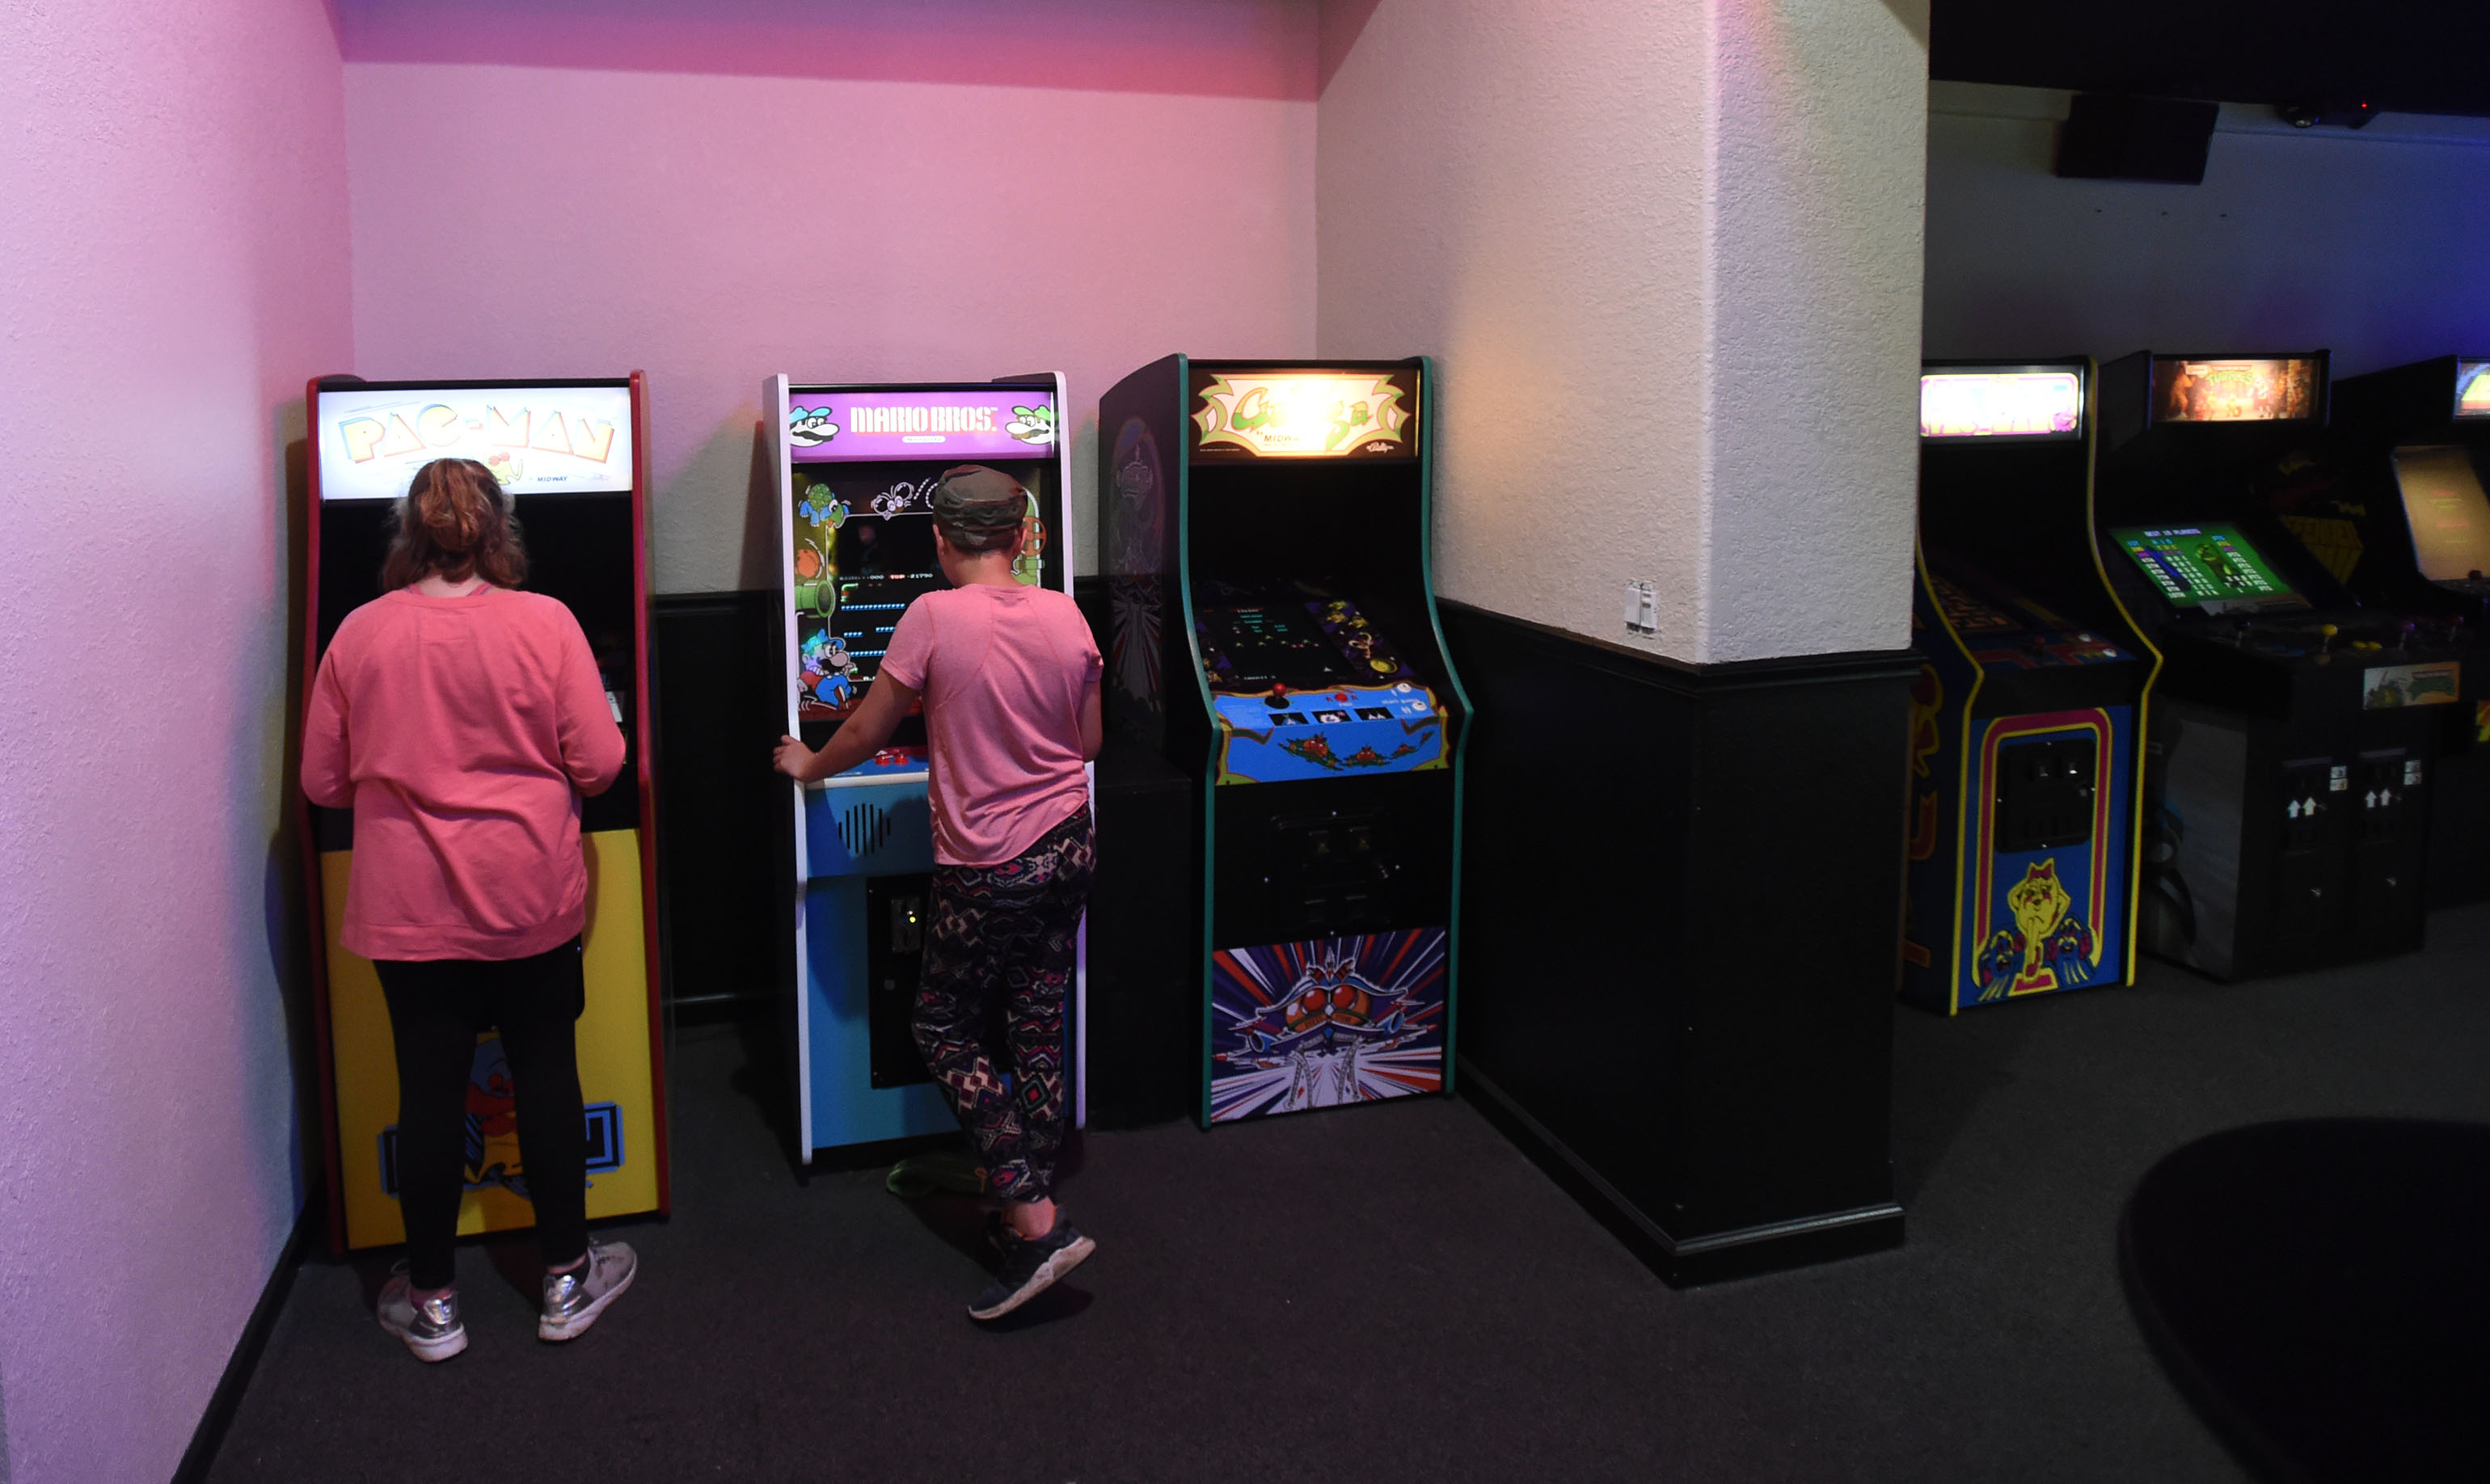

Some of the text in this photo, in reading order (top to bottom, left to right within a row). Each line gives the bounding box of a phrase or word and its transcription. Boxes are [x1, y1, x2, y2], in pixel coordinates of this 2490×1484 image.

[850, 407, 929, 433] MARIO
[338, 403, 616, 465] PAC-MAN
[1264, 433, 1306, 443] MIDW
[537, 475, 568, 483] MIDWAY
